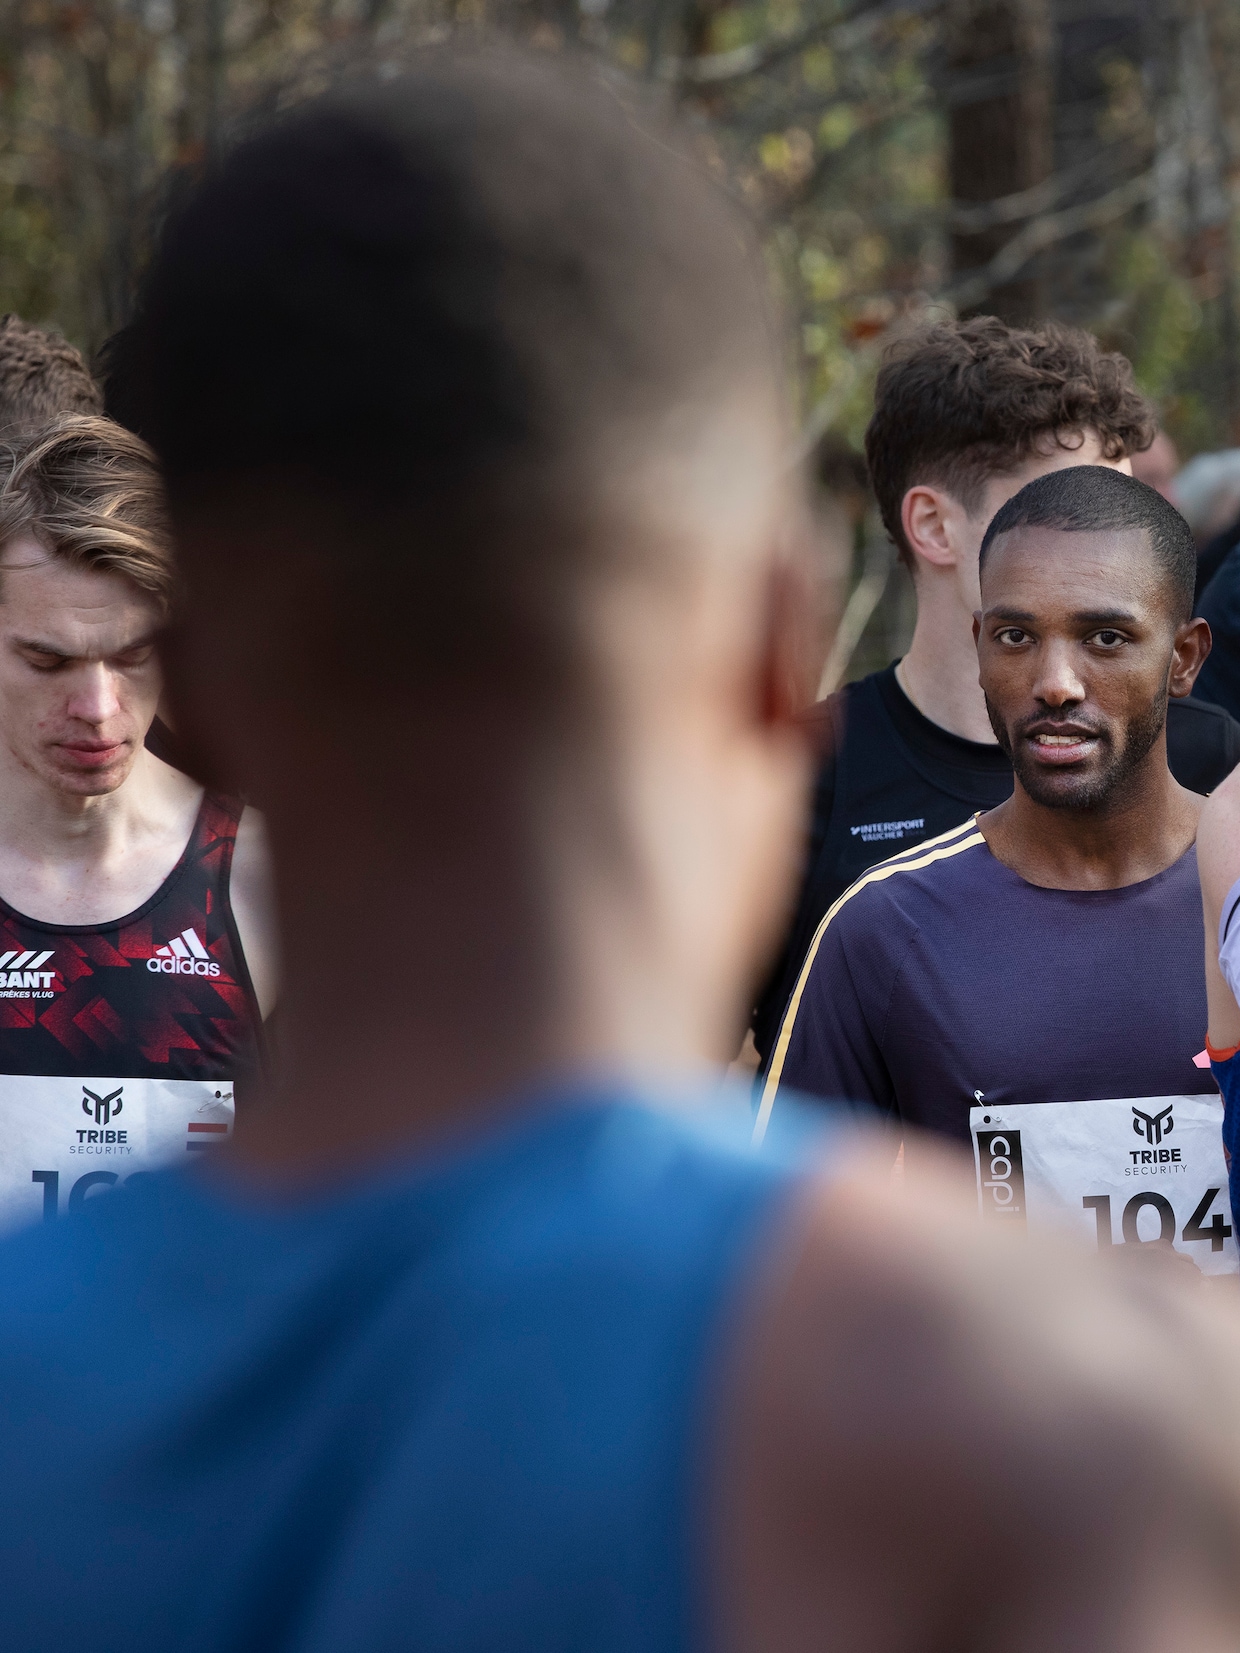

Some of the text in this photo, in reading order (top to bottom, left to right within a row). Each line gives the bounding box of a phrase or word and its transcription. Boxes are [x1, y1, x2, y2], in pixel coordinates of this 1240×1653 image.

[860, 819, 925, 834] INTERSPORT
[146, 956, 221, 977] adidas
[32, 991, 55, 999] VLUG
[76, 1130, 127, 1144] TRIBE
[69, 1145, 132, 1155] SECURITY
[1130, 1148, 1182, 1165] TRIBE
[984, 1136, 1020, 1212] capi
[1124, 1164, 1188, 1176] SECURITY
[1082, 1187, 1232, 1252] 104
